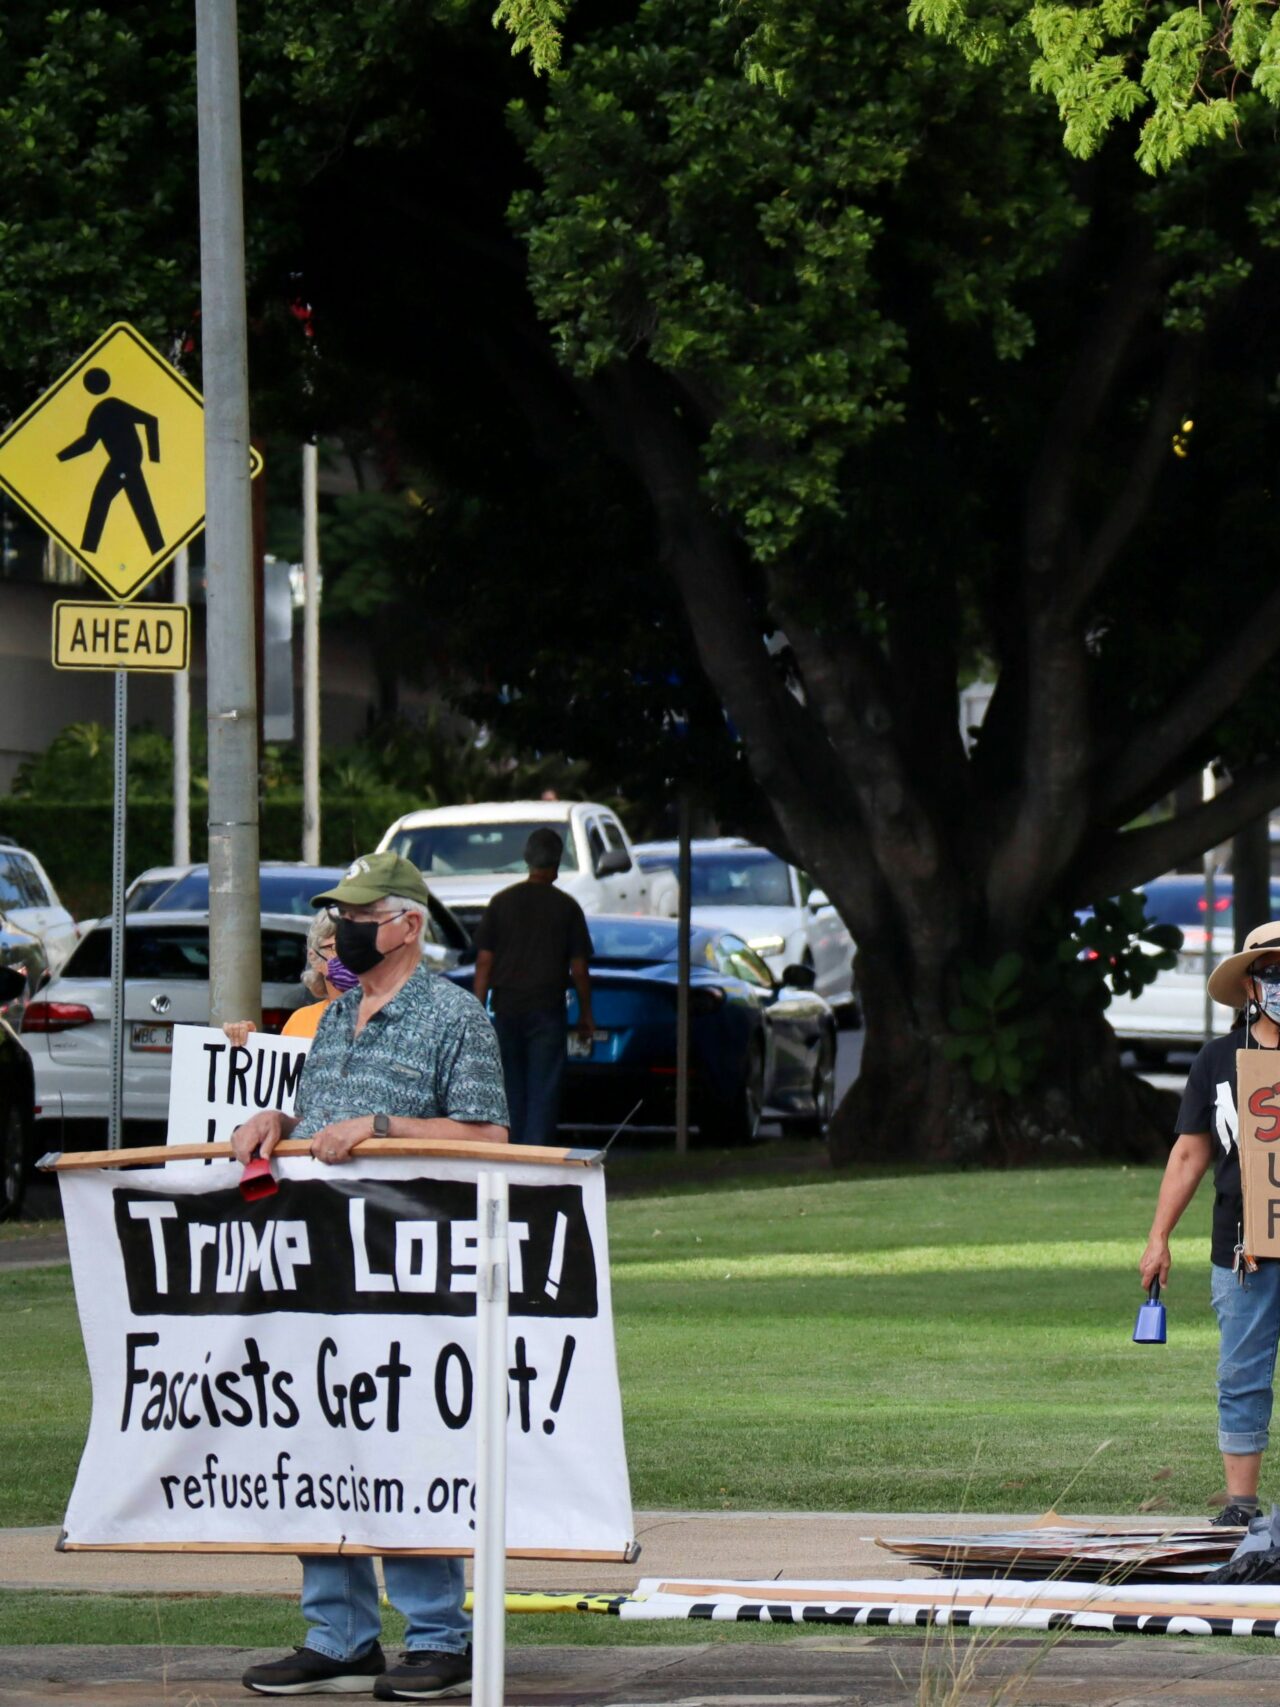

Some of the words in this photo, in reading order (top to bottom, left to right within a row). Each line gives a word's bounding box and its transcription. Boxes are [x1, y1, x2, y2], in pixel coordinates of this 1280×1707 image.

[70, 618, 173, 655] AHEAD
[203, 1043, 307, 1110] TRUM
[120, 1332, 299, 1433] Fascists
[317, 1336, 411, 1432] Get
[434, 1335, 576, 1435] Ot!
